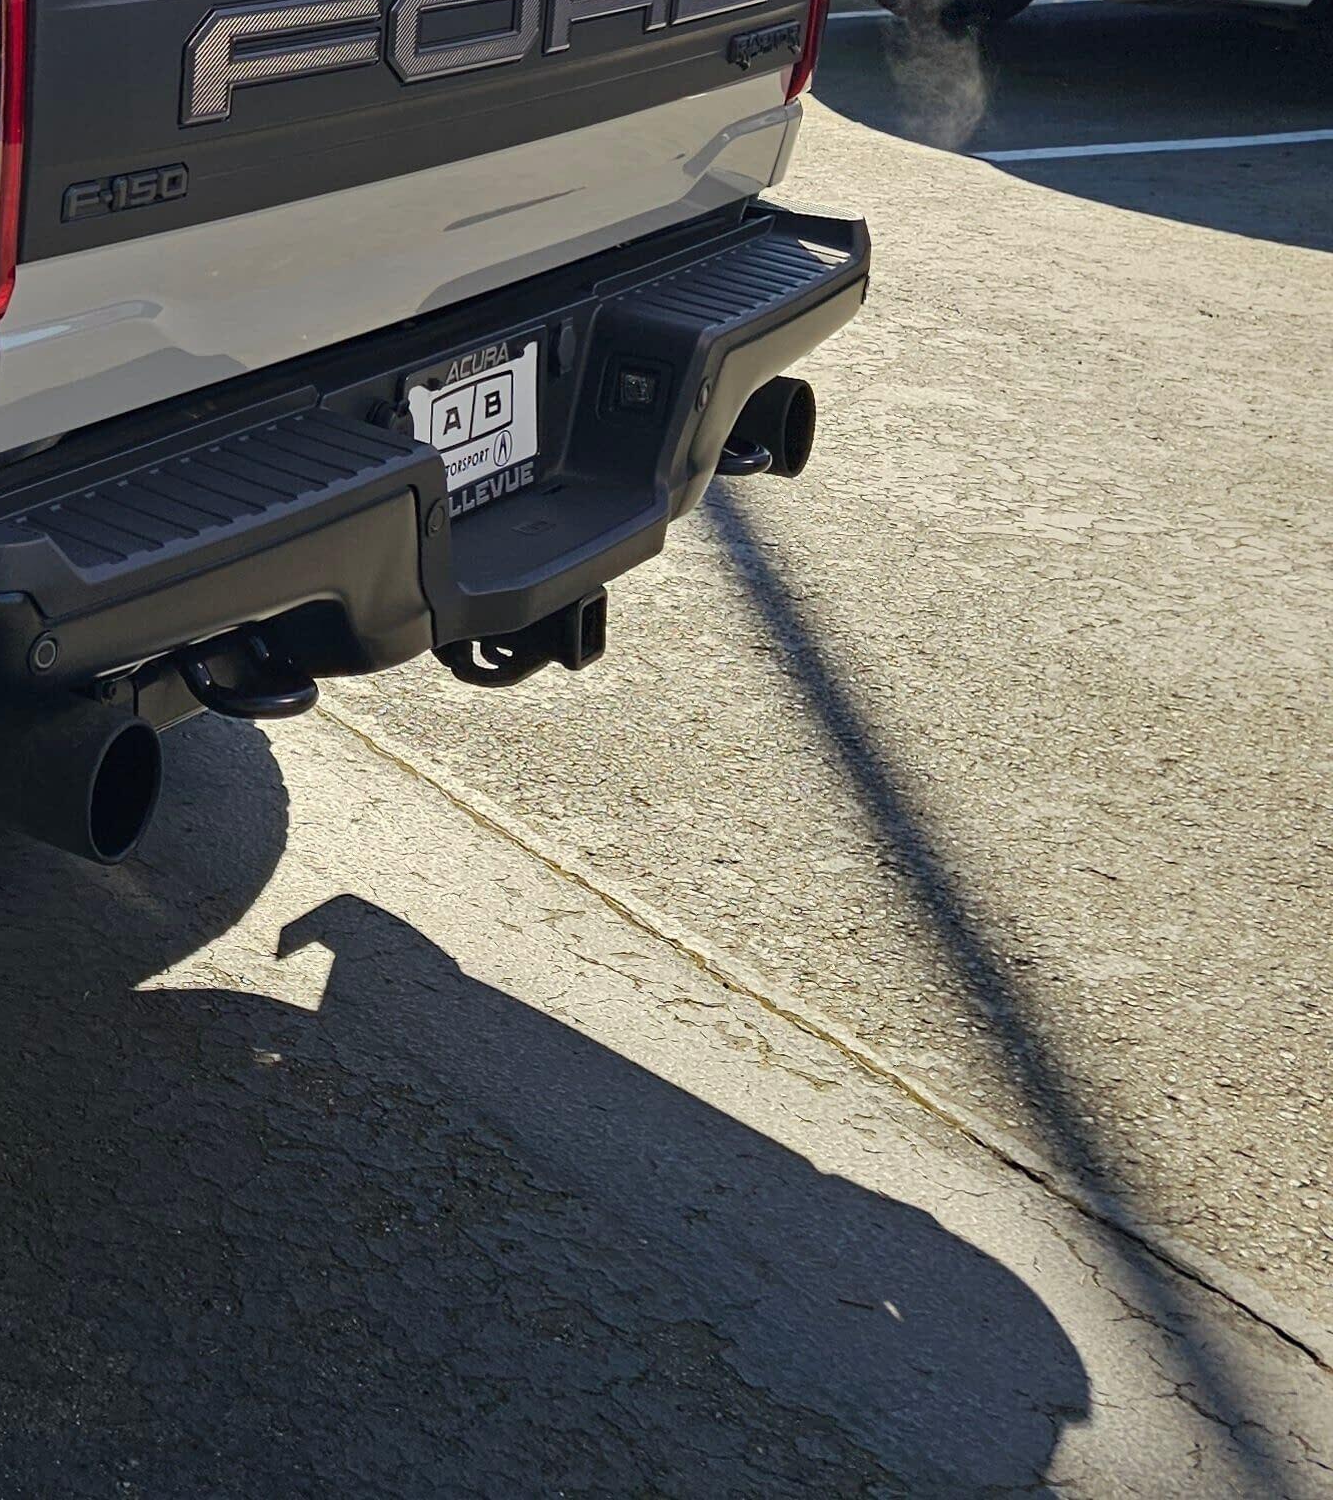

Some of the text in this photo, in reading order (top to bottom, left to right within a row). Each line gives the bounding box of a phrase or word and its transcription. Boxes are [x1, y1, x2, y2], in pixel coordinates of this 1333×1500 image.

[60, 162, 189, 224] F-150
[445, 342, 509, 384] ACURA
[443, 390, 501, 436] A B
[449, 460, 533, 518] LLEVUE
